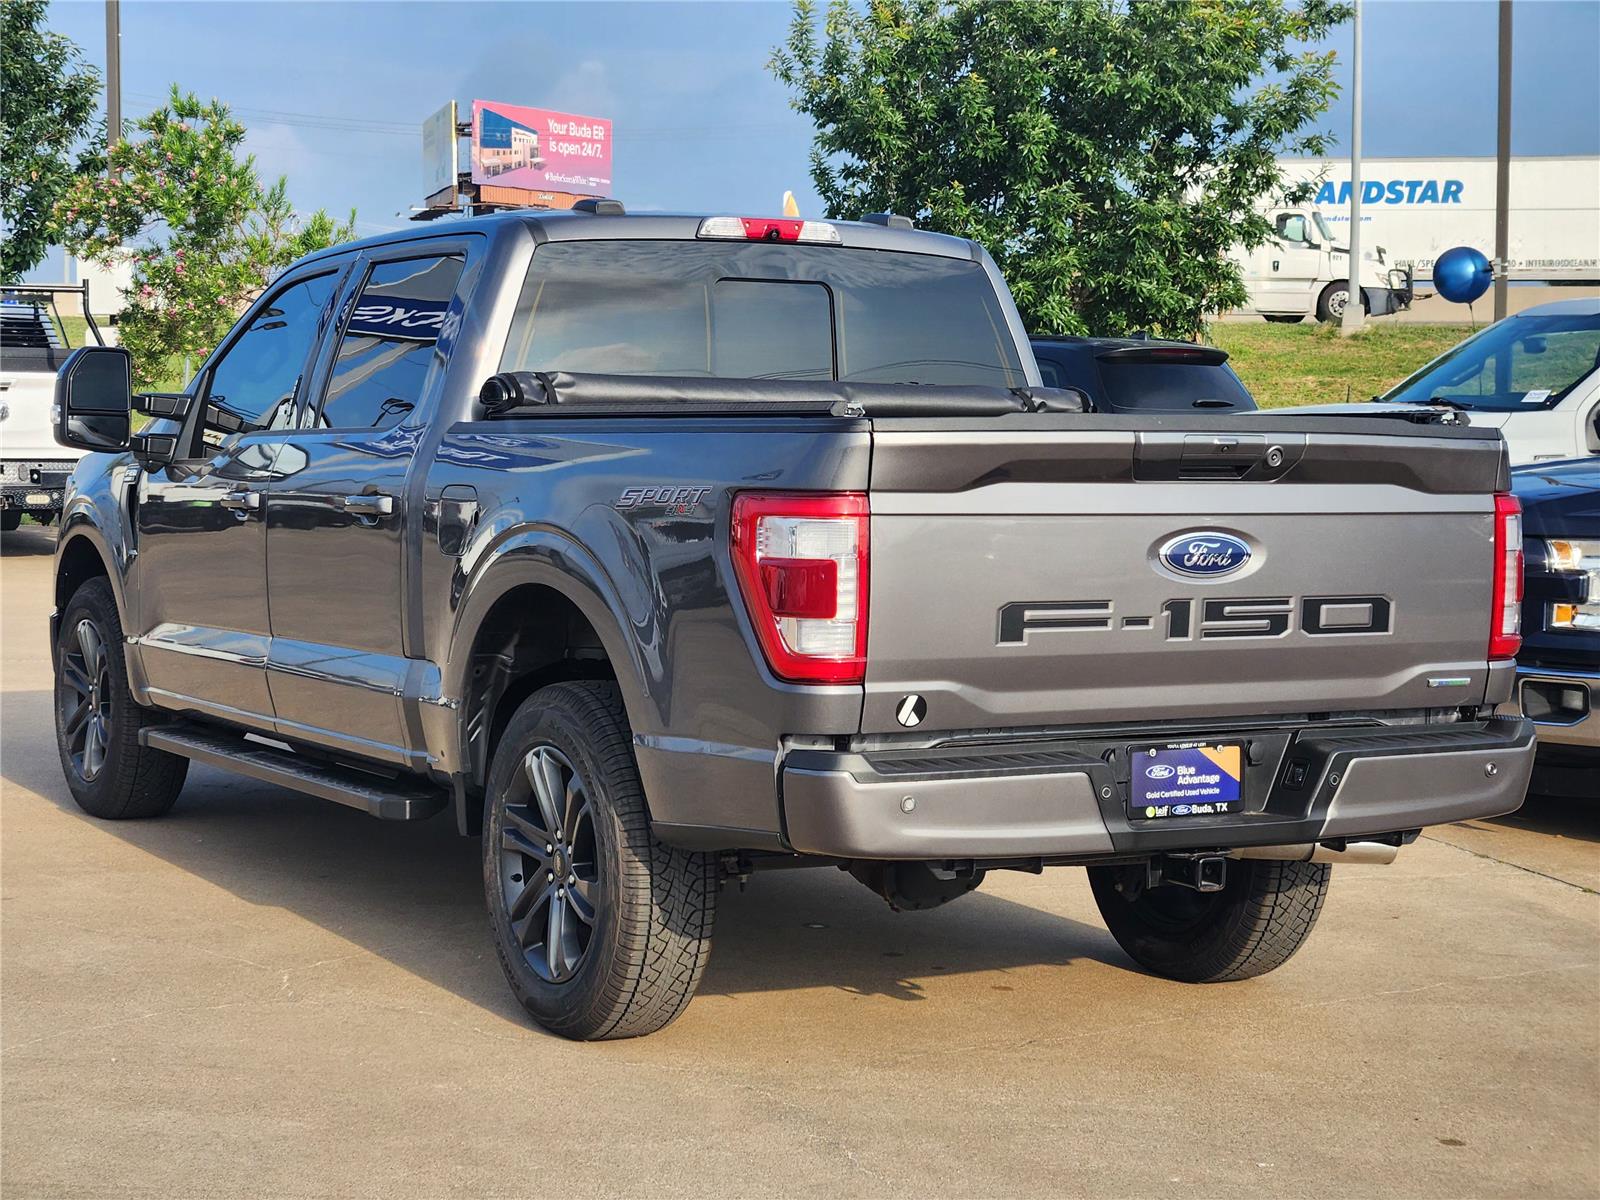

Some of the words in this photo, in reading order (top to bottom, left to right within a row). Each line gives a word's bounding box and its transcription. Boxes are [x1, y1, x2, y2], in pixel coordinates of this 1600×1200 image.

[547, 119, 568, 135] Your
[569, 121, 592, 138] Buda
[592, 125, 605, 140] ER
[549, 136, 557, 152] is
[558, 142, 581, 157] open
[581, 142, 603, 158] 24/7.
[1313, 180, 1465, 205] ANDSTAR
[615, 486, 713, 510] SPORT
[1183, 541, 1233, 567] Ford
[996, 595, 1394, 646] F-150
[1177, 765, 1196, 775] Blue
[1177, 774, 1220, 785] Advantage
[1146, 791, 1160, 799] Gold
[1160, 789, 1185, 798] Certified
[1185, 788, 1200, 796] Used
[1200, 787, 1220, 795] Vehicle
[1191, 804, 1214, 814] Buda,
[1215, 803, 1228, 812] TX
